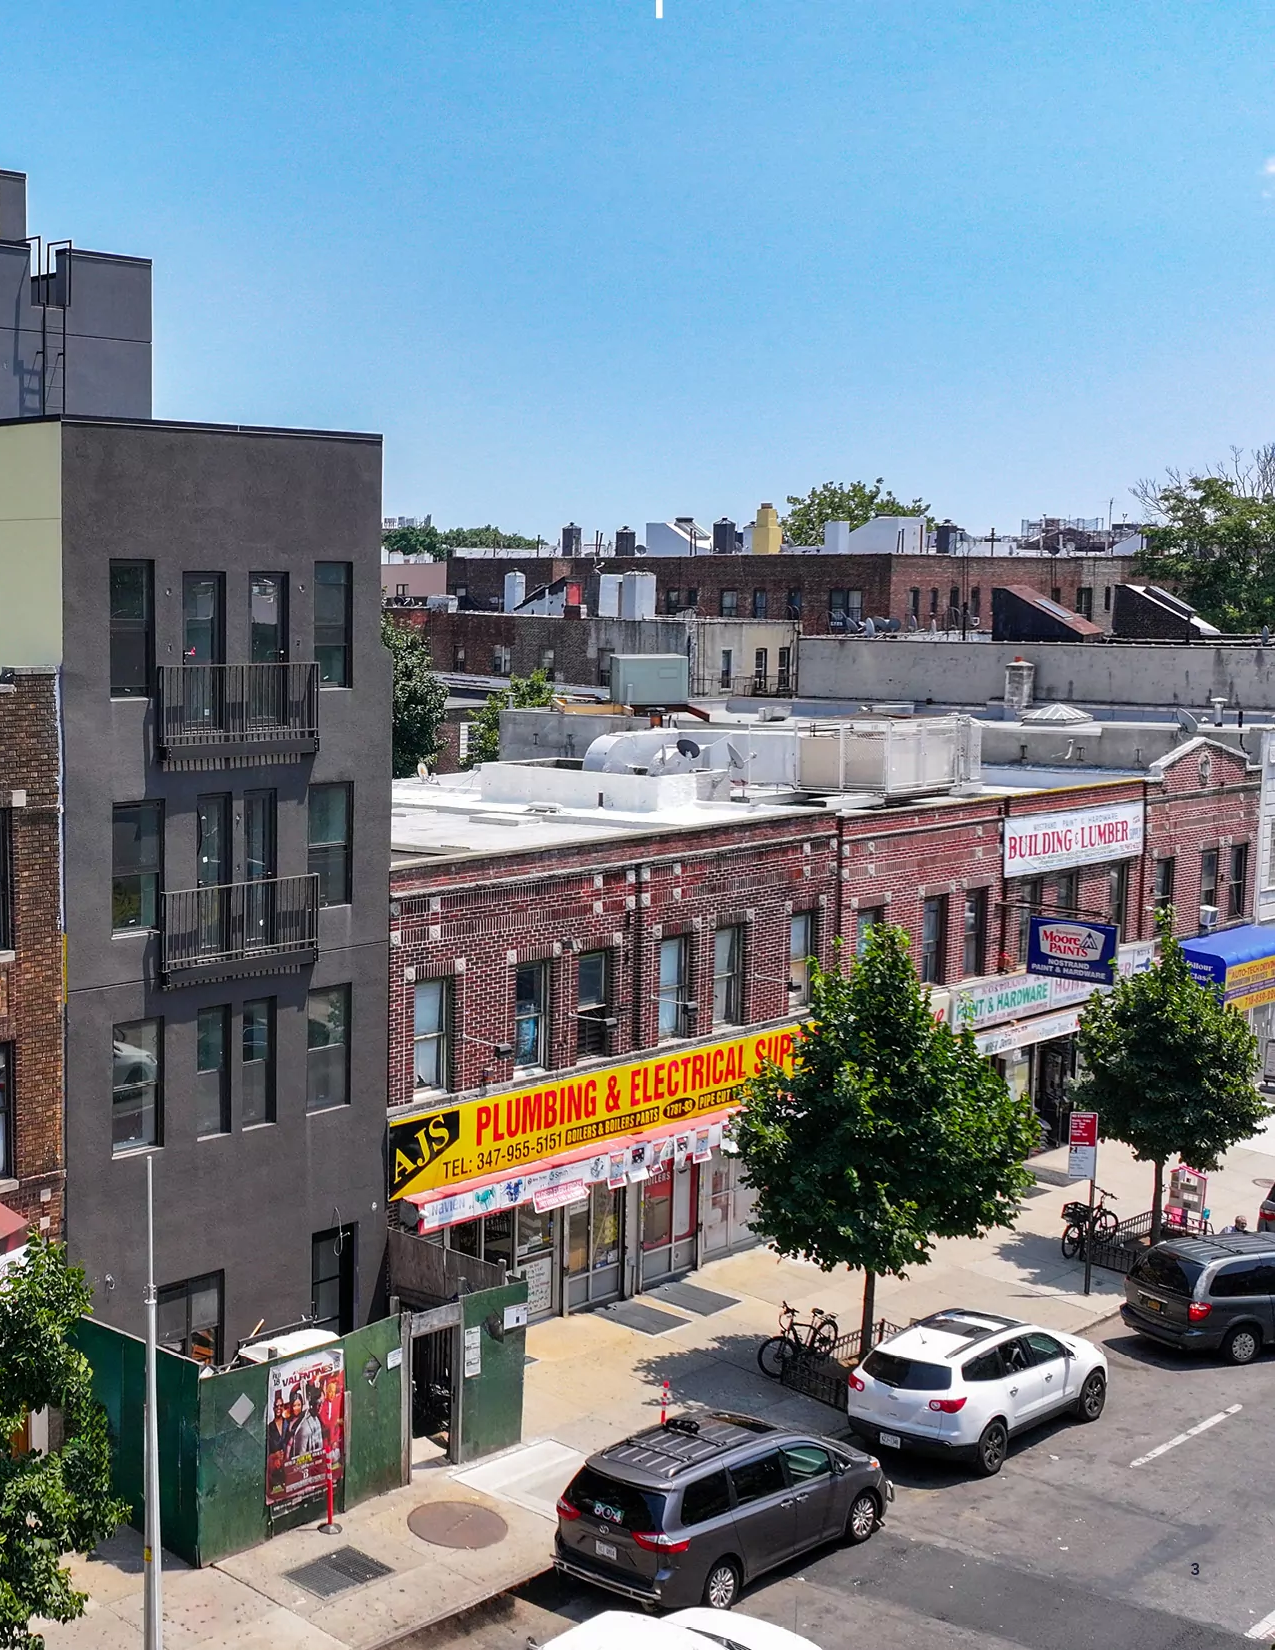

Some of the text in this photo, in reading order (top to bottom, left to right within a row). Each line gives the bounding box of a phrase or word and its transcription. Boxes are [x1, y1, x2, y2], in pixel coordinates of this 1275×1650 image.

[1008, 829, 1073, 860] BUILDING
[1080, 820, 1129, 849] LUMBER
[1042, 929, 1081, 946] Moore
[1048, 942, 1089, 958] PAINTS
[1031, 963, 1106, 980] PAINT & HARDWARE
[1047, 958, 1090, 970] NOSTRAND
[987, 996, 994, 1014] &
[996, 982, 1048, 1011] HARDWARE
[476, 1079, 597, 1147] PLUMBING
[605, 1075, 622, 1114] &
[630, 1044, 747, 1108] ELECTRICAL
[699, 1092, 716, 1109] PIPE
[716, 1088, 731, 1103] CUT
[566, 1126, 598, 1146] BOILERS
[605, 1114, 636, 1134] BOILERS
[635, 1108, 659, 1127] PARTS
[393, 1114, 450, 1185] AJS
[443, 1130, 562, 1179] TEL: 347-955-5151
